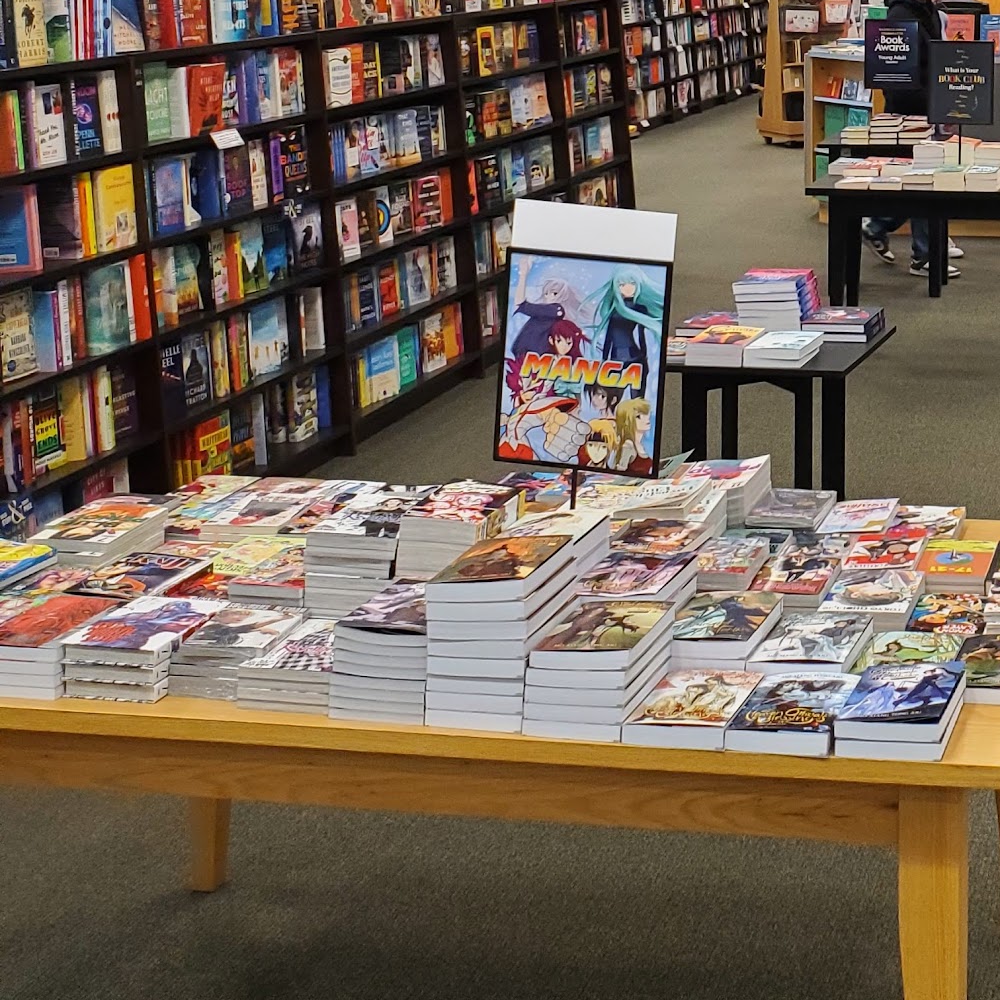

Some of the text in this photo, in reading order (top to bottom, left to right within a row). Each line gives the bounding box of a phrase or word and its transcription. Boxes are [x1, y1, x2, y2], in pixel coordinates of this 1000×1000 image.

[880, 36, 903, 45] Book
[874, 43, 910, 52] Awards
[938, 75, 985, 84] BOOK CLUB
[520, 352, 643, 390] MANGA
